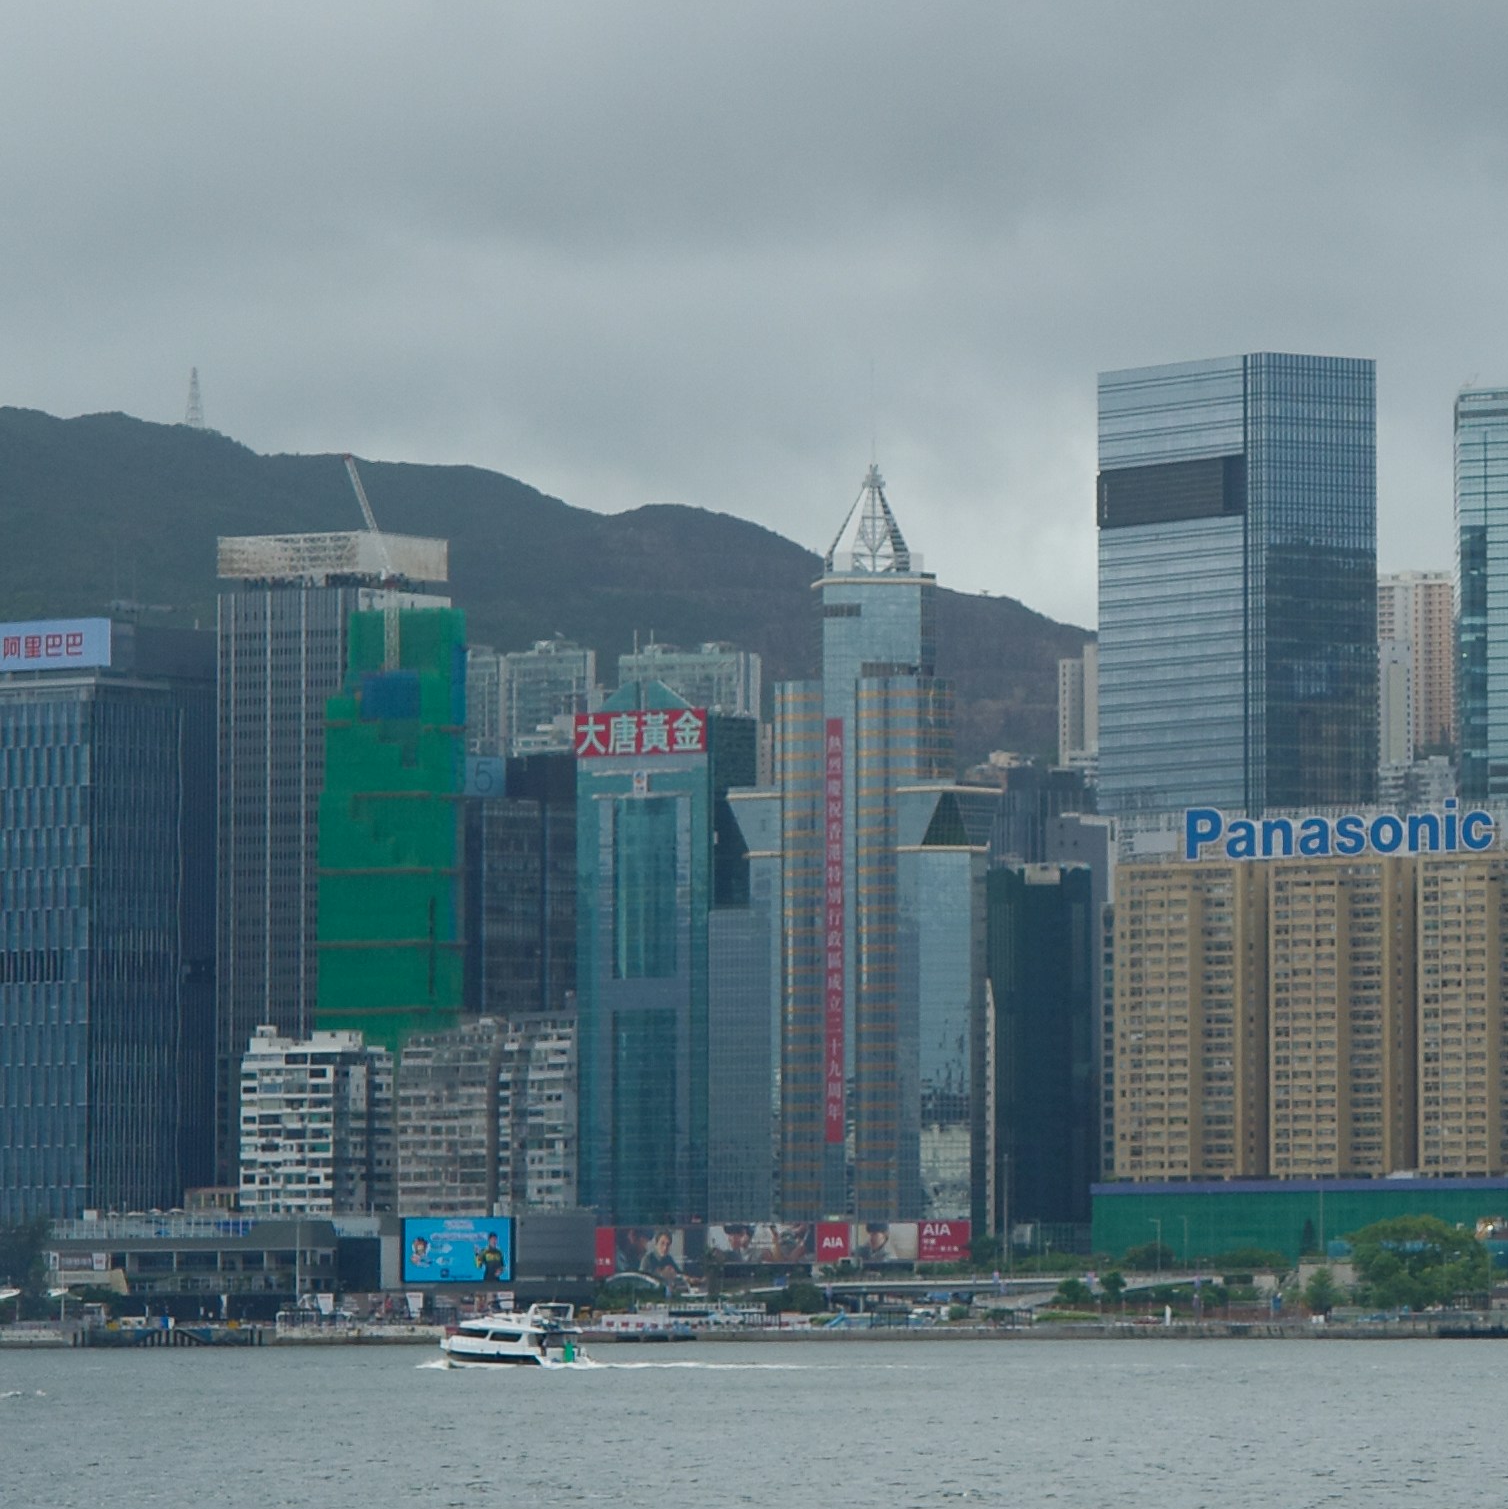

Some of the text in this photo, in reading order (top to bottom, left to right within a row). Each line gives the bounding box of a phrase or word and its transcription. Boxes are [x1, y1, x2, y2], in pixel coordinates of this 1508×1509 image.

[3, 632, 83, 660] 阿里巴巴
[1185, 797, 1495, 861] Panasonic
[922, 1223, 951, 1236] AIA
[822, 1236, 844, 1249] AIA
